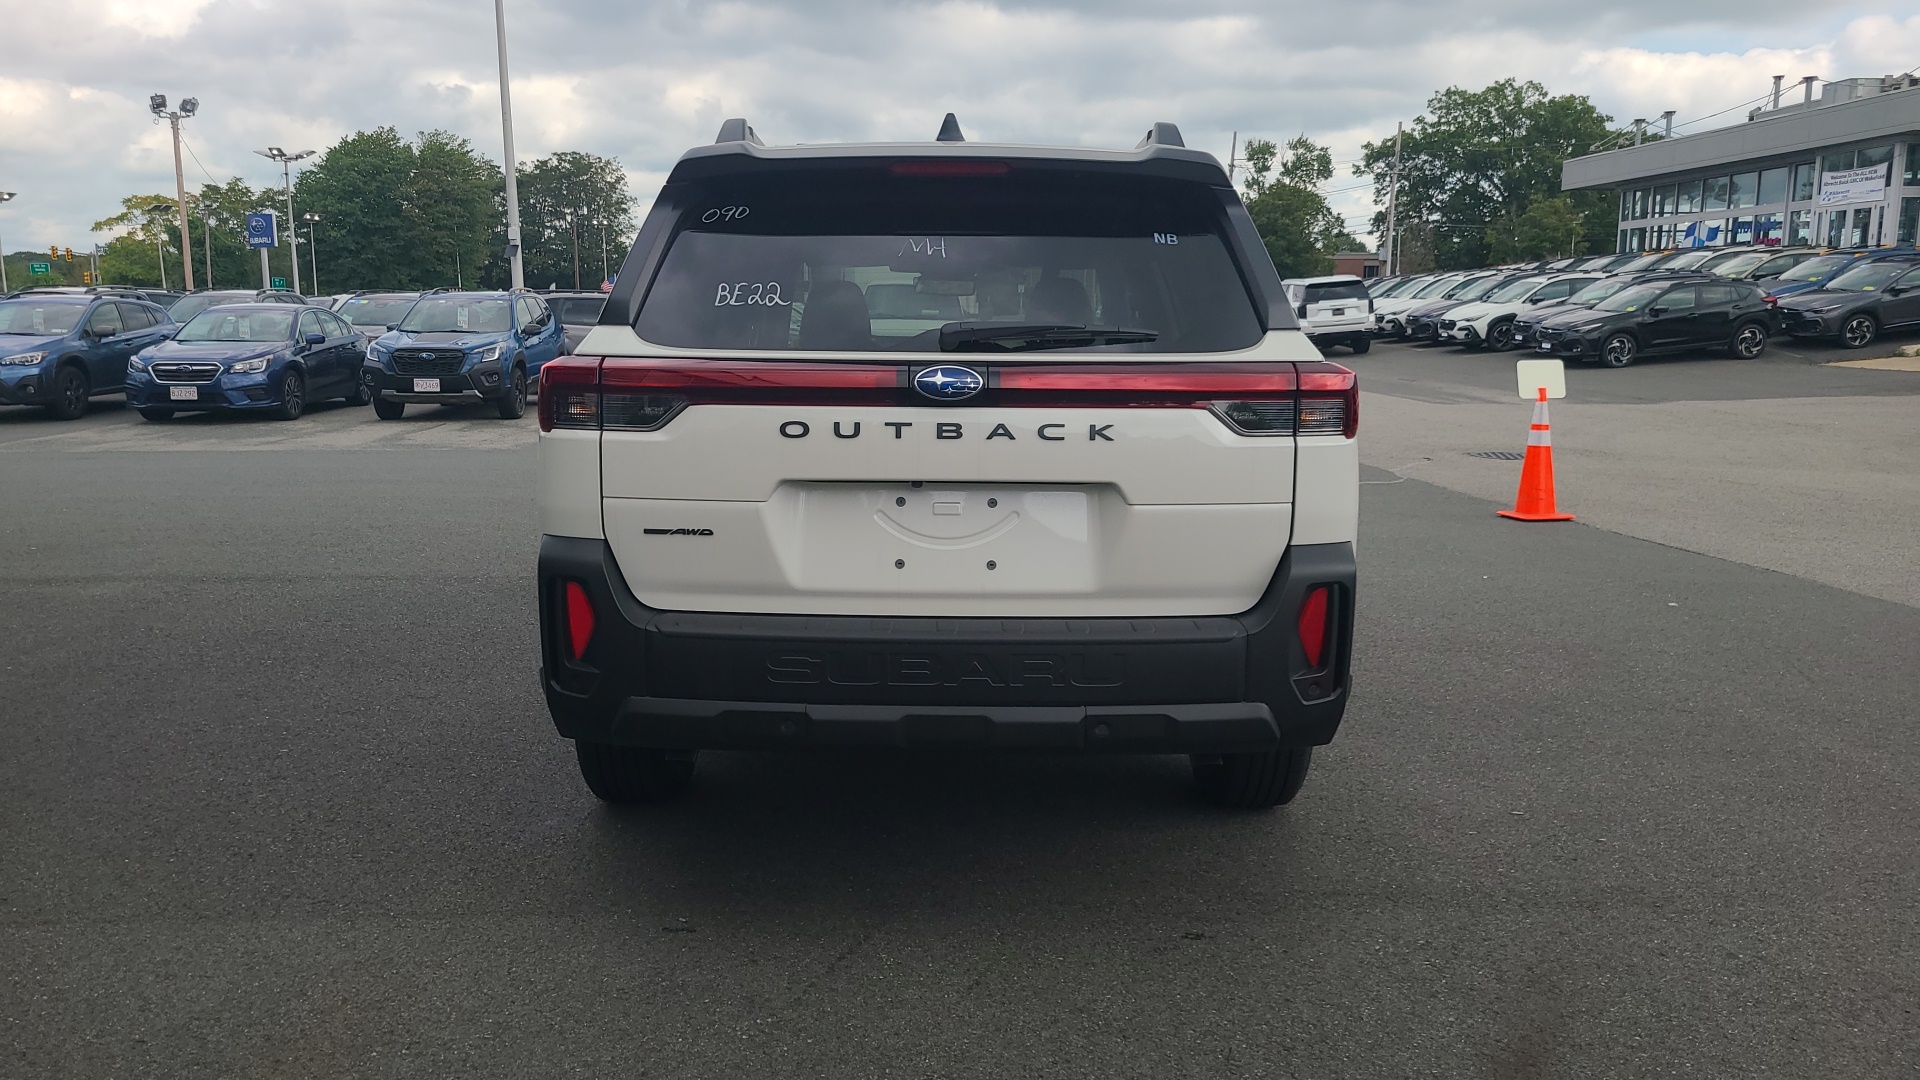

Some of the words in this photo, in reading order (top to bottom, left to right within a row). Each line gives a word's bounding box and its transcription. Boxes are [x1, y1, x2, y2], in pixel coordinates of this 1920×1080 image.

[1153, 232, 1179, 245] NB
[715, 282, 791, 306] BE22
[779, 420, 1115, 441] OUTBACK
[669, 528, 714, 536] AWD
[767, 651, 1128, 688] SUBARU
